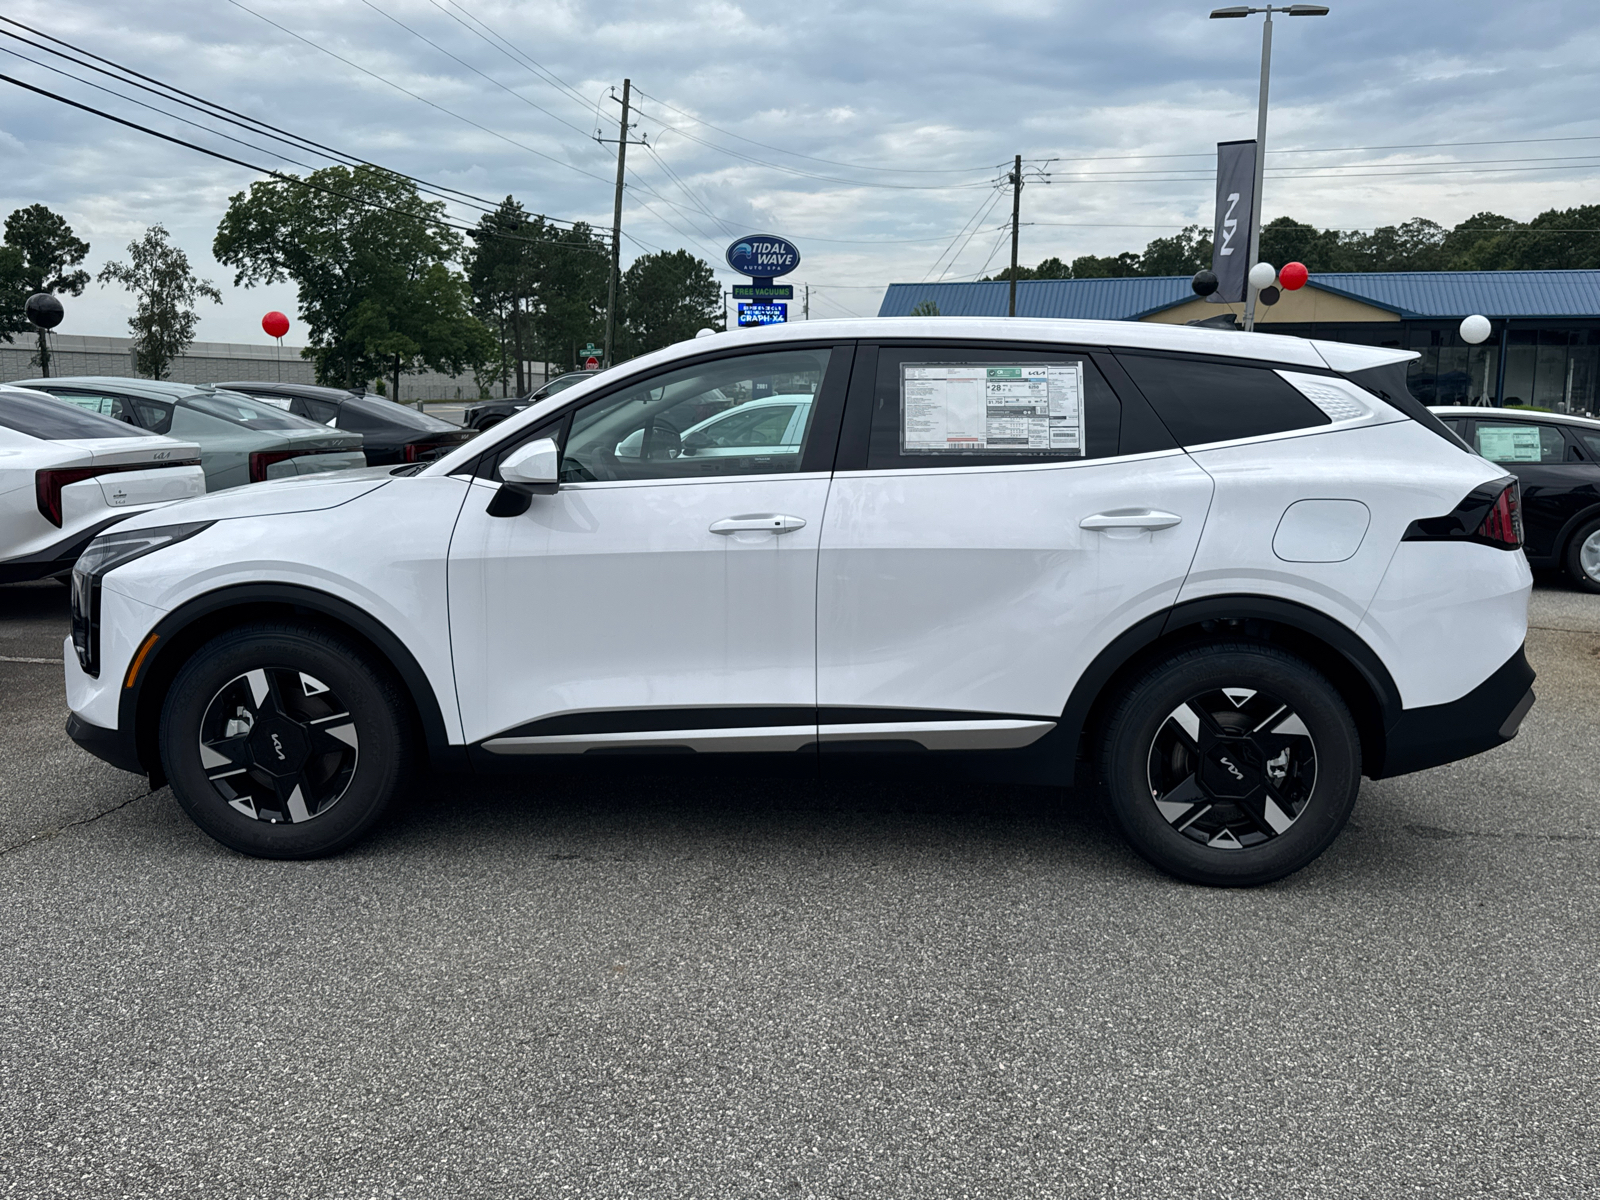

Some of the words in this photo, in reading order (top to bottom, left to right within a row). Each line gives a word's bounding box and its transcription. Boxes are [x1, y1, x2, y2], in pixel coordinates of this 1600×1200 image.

[752, 242, 786, 254] TIDAL
[757, 254, 793, 265] WAVE
[735, 288, 754, 296] FREE
[755, 288, 790, 296] VACUUMS
[991, 384, 1002, 392] 28
